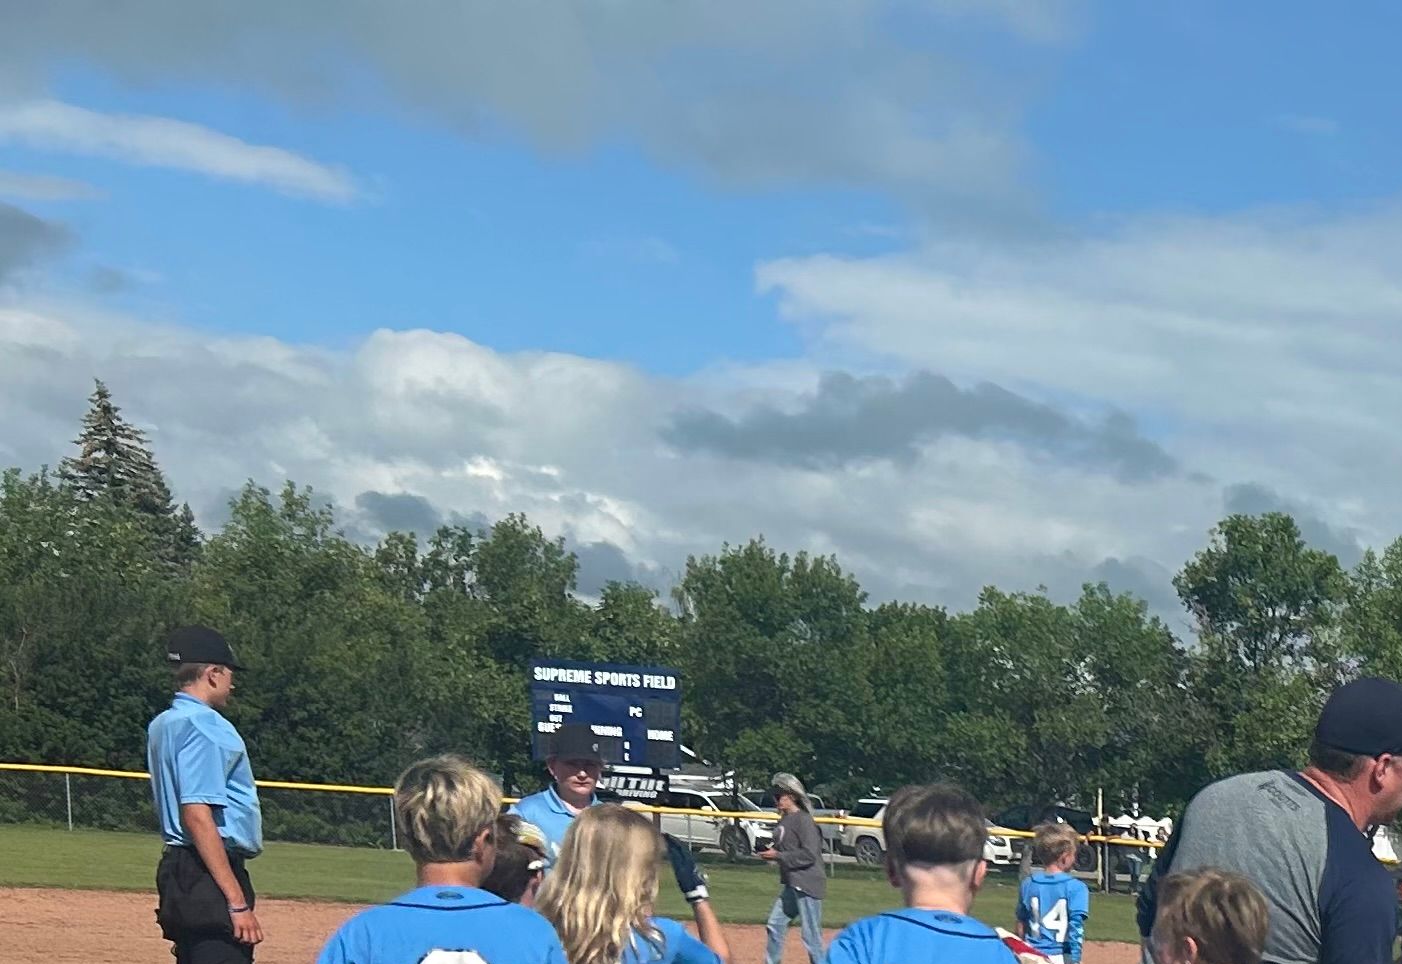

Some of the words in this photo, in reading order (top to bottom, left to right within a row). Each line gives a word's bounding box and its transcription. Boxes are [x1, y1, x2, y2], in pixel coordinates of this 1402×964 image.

[533, 666, 592, 685] SUPREME
[594, 671, 641, 688] SPORTS
[643, 674, 676, 690] FIELD
[629, 706, 643, 718] PC
[537, 721, 562, 733] GUE
[1030, 896, 1069, 943] 14
